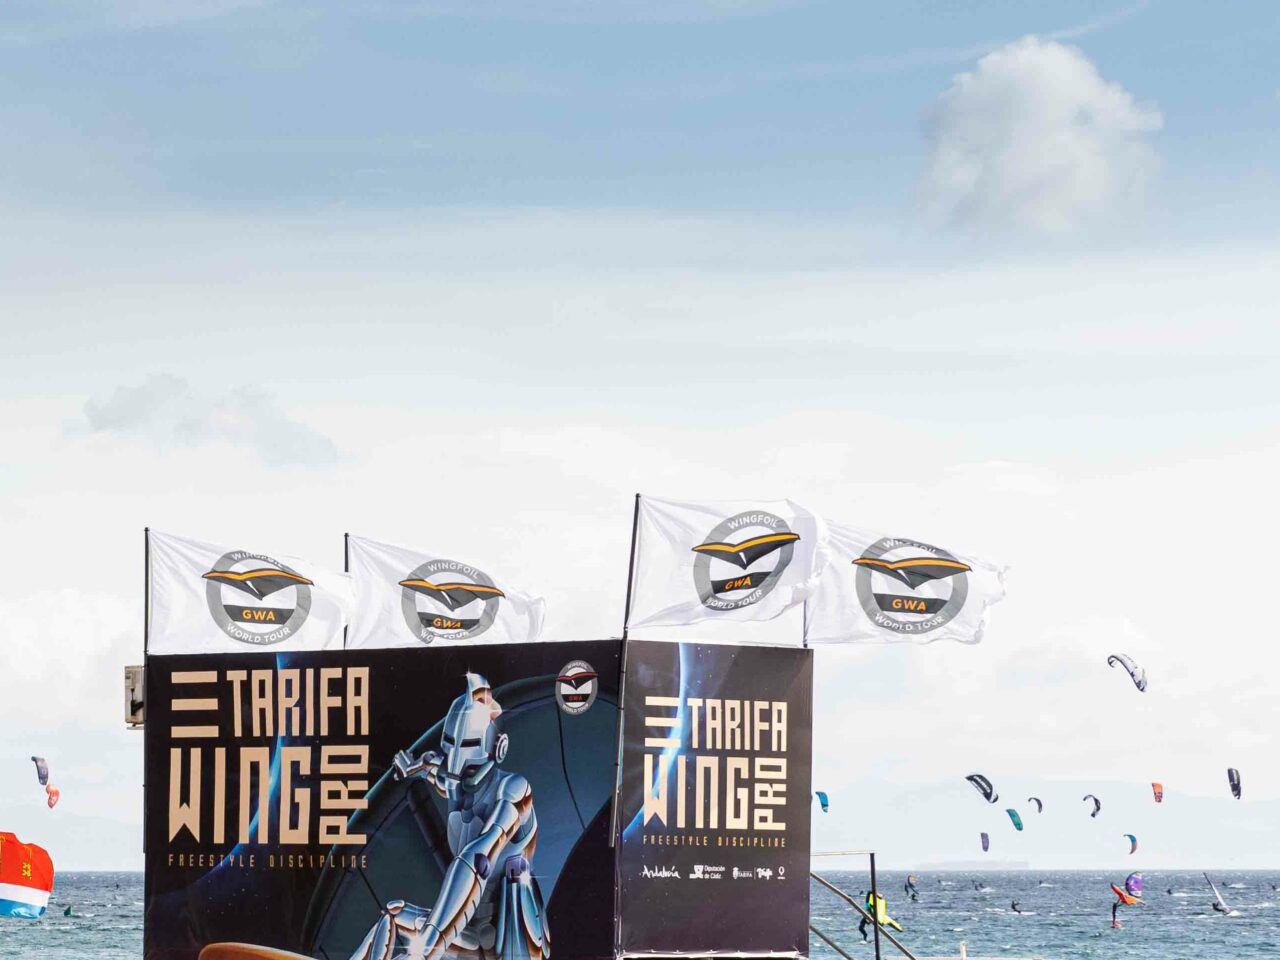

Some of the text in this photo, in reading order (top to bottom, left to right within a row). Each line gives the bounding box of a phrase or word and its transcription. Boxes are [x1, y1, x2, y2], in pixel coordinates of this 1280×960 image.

[728, 514, 778, 529] WINGFOIL
[427, 562, 479, 579] WINGFOIL
[725, 576, 752, 590] GWA
[738, 589, 762, 607] TOUR
[892, 599, 927, 611] GWA
[242, 609, 275, 620] GWA
[875, 613, 945, 631] WORLD TOUR
[227, 622, 291, 643] WORLD TOUR
[226, 667, 369, 737] TARIFA
[687, 698, 787, 752] TARIFA
[169, 745, 370, 845] WING PRO
[643, 754, 787, 830] WING PRO
[643, 835, 785, 848] FREESTYLE DISCIPLINE
[169, 854, 367, 868] FREESTYLE DISCIPLINE
